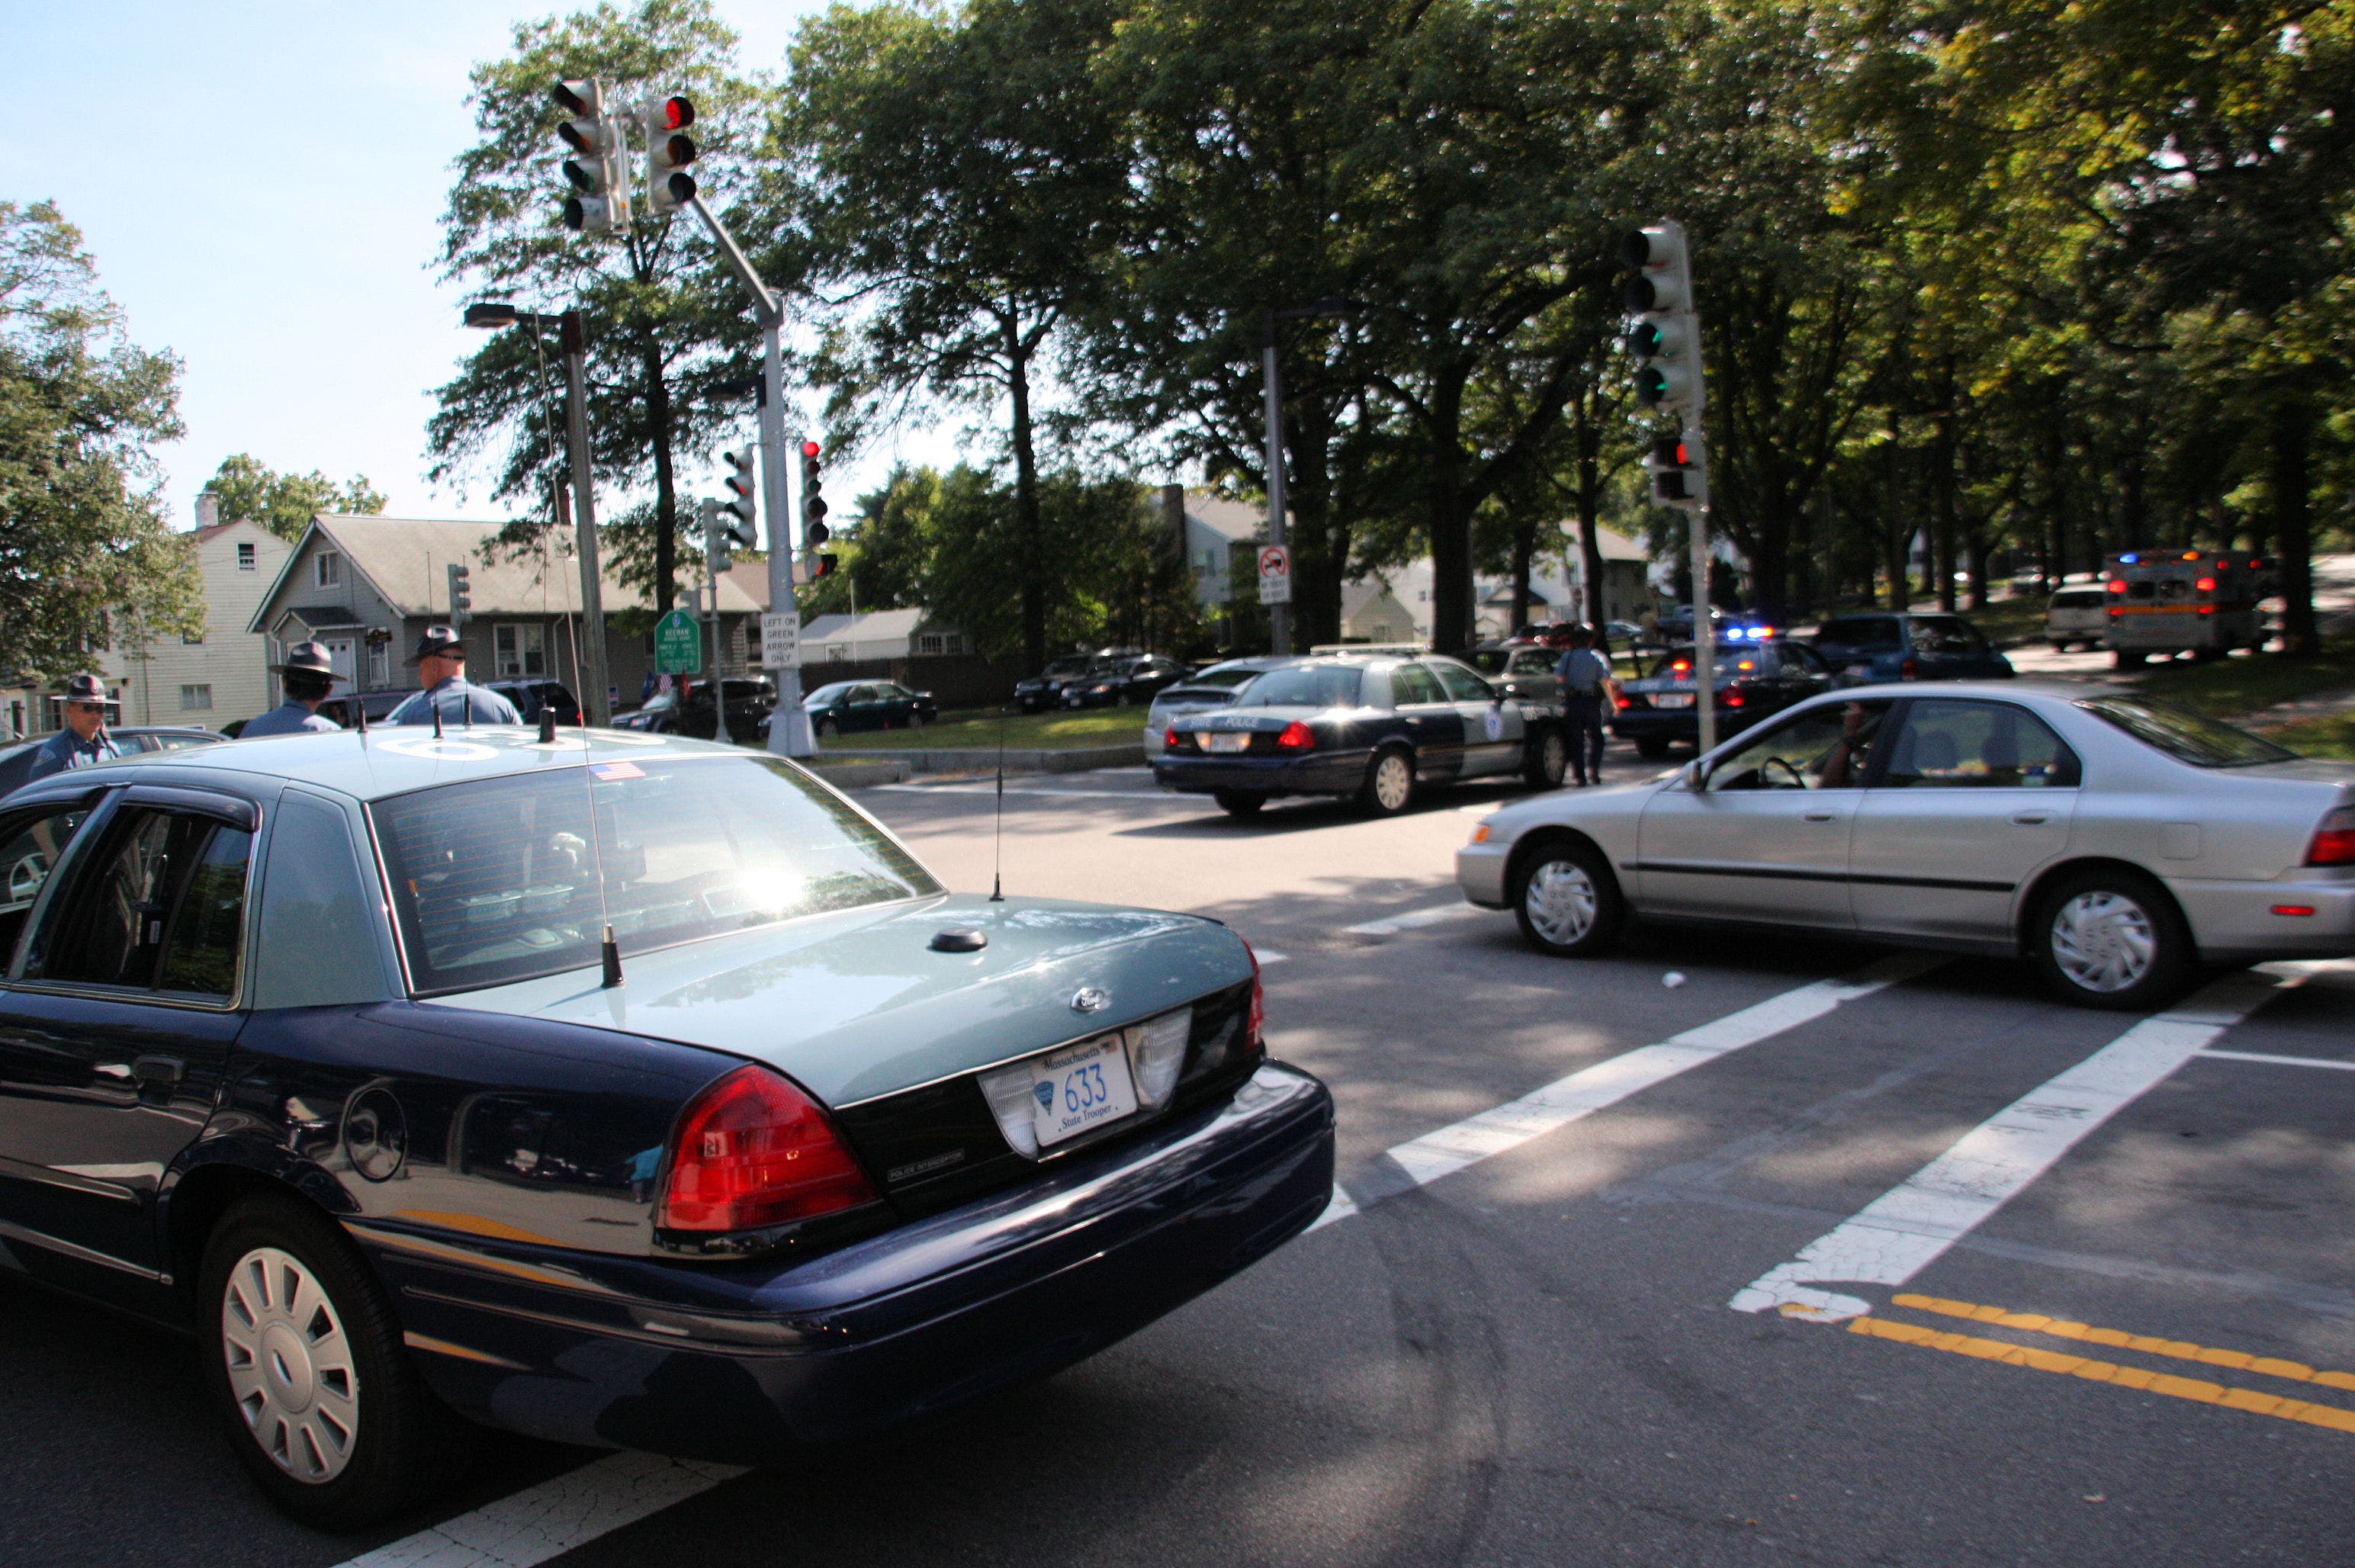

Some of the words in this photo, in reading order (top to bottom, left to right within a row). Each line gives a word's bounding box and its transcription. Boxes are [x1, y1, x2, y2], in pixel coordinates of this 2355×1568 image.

[763, 617, 782, 627] LEFT
[785, 616, 795, 625] ON
[767, 629, 793, 639] GREEN
[766, 641, 795, 651] ARROW
[771, 654, 791, 664] ONLY
[1190, 717, 1211, 728] STATE
[1226, 716, 1258, 728] POLICE
[1043, 1047, 1100, 1072] Massachusetts
[1064, 1062, 1107, 1112] 633
[1061, 1114, 1081, 1129] State
[1082, 1104, 1112, 1121] Trooper
